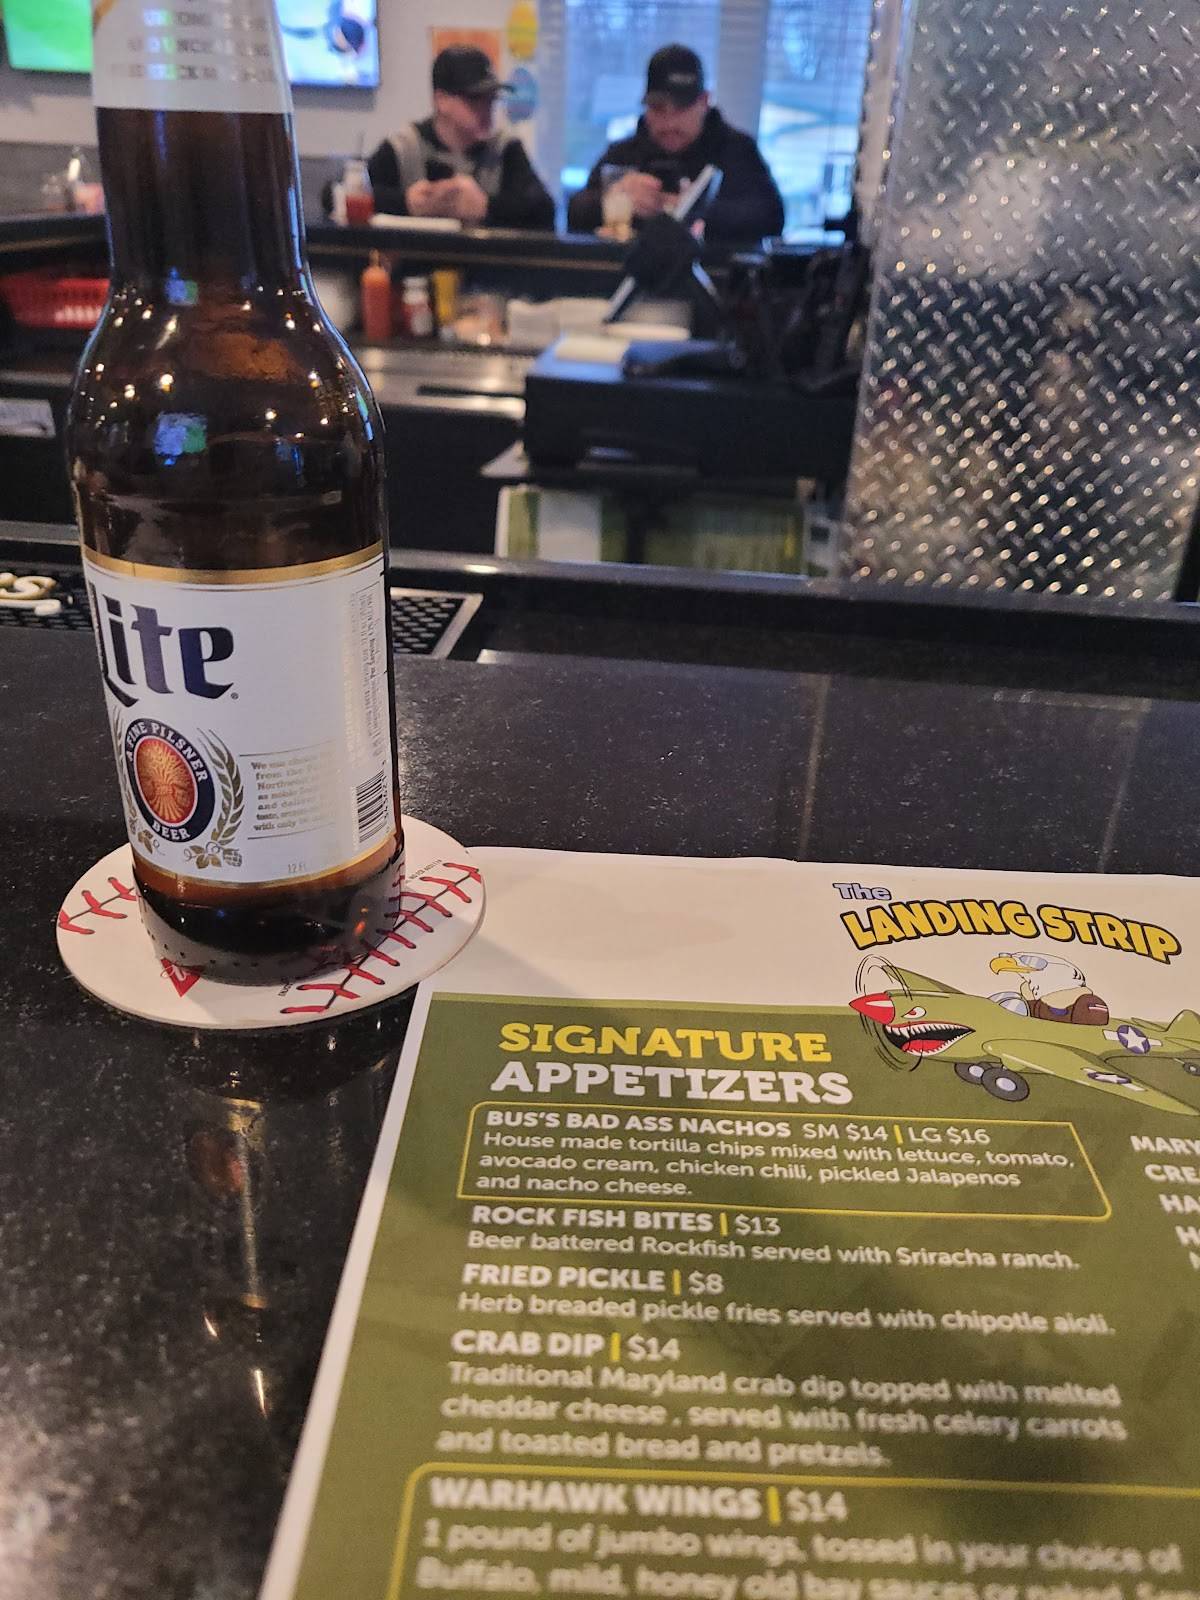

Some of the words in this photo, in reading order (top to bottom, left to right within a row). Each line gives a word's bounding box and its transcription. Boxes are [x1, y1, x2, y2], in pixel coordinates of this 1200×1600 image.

[126, 722, 148, 748] FINE
[151, 722, 208, 782] PILSNER
[152, 820, 191, 841] BEER
[833, 882, 892, 901] The
[841, 899, 1040, 951] LANDING
[1038, 904, 1182, 964] STRIP
[499, 1022, 832, 1062] SIGNATURE
[490, 1061, 853, 1104] APPETIZERS
[486, 1110, 561, 1129] BUS'S
[565, 1113, 619, 1130] BAD
[625, 1115, 673, 1132] ASS
[680, 1117, 791, 1138] NACHOS
[802, 1122, 840, 1140] SM
[846, 1123, 888, 1142] $14
[908, 1126, 942, 1143] LG
[946, 1126, 990, 1145] $16
[484, 1131, 555, 1148] House
[560, 1134, 623, 1150] made
[629, 1135, 701, 1154] tortilla
[706, 1140, 765, 1159] chips
[771, 1142, 837, 1160] mixed
[843, 1147, 892, 1162] with
[897, 1148, 981, 1166] lettuce,
[986, 1151, 1075, 1169] tomato,
[476, 1174, 521, 1190] and
[527, 1177, 600, 1193] nacho
[604, 1178, 693, 1196] cheese.
[479, 1154, 577, 1171] avocado
[582, 1158, 659, 1174] cream,
[665, 1159, 754, 1178] chicken
[759, 1162, 810, 1181] chili,
[818, 1166, 899, 1185] pickled
[906, 1168, 1022, 1188] Jalapenos
[472, 1206, 556, 1226] ROCK
[562, 1208, 626, 1228] FISH
[633, 1212, 714, 1232] BITES
[734, 1214, 781, 1237] $13
[466, 1230, 525, 1250] Beer
[530, 1232, 634, 1253] battered
[641, 1236, 745, 1259] Rockfish
[751, 1243, 831, 1262] served
[837, 1247, 892, 1264] with
[896, 1247, 997, 1268] Sriracha
[1002, 1249, 1081, 1270] ranch.
[462, 1263, 552, 1287] FRIED
[558, 1267, 666, 1292] PICKLE
[688, 1270, 724, 1295] $8
[457, 1292, 524, 1314] Herb
[529, 1295, 636, 1318] breaded
[642, 1299, 720, 1322] pickle
[725, 1302, 780, 1324] fries
[786, 1308, 871, 1327] served
[878, 1309, 935, 1329] with
[941, 1310, 1048, 1336] chipotle
[1053, 1312, 1116, 1335] aioli.
[452, 1330, 542, 1356] CRAB
[549, 1332, 605, 1356] DIP
[628, 1334, 681, 1362] $14
[449, 1361, 593, 1388] Traditional
[600, 1366, 728, 1396] Maryland
[733, 1373, 796, 1396] crab
[801, 1376, 845, 1401] dip
[850, 1376, 951, 1402] topped
[956, 1379, 1018, 1402] with
[440, 1394, 560, 1420] cheddar
[564, 1398, 667, 1425] cheese
[687, 1404, 782, 1428] served
[787, 1407, 850, 1432] with
[856, 1408, 930, 1434] fresh
[934, 1412, 1020, 1442] celery
[1025, 1415, 1128, 1441] carrots
[435, 1428, 494, 1452] and
[500, 1430, 610, 1458] toasted
[615, 1433, 699, 1460] bread
[705, 1437, 762, 1463] and
[430, 1476, 628, 1514] WARHAWK
[633, 1482, 762, 1519] WINGS
[786, 1487, 848, 1523] $14
[423, 1518, 441, 1548] 1
[446, 1522, 553, 1552] pound
[556, 1522, 594, 1552] of
[594, 1524, 700, 1561] jumbo
[810, 1532, 918, 1564] tossed
[920, 1533, 954, 1565] in
[956, 1540, 1030, 1575] your
[1036, 1538, 1144, 1574] choice
[1148, 1542, 1184, 1575] of
